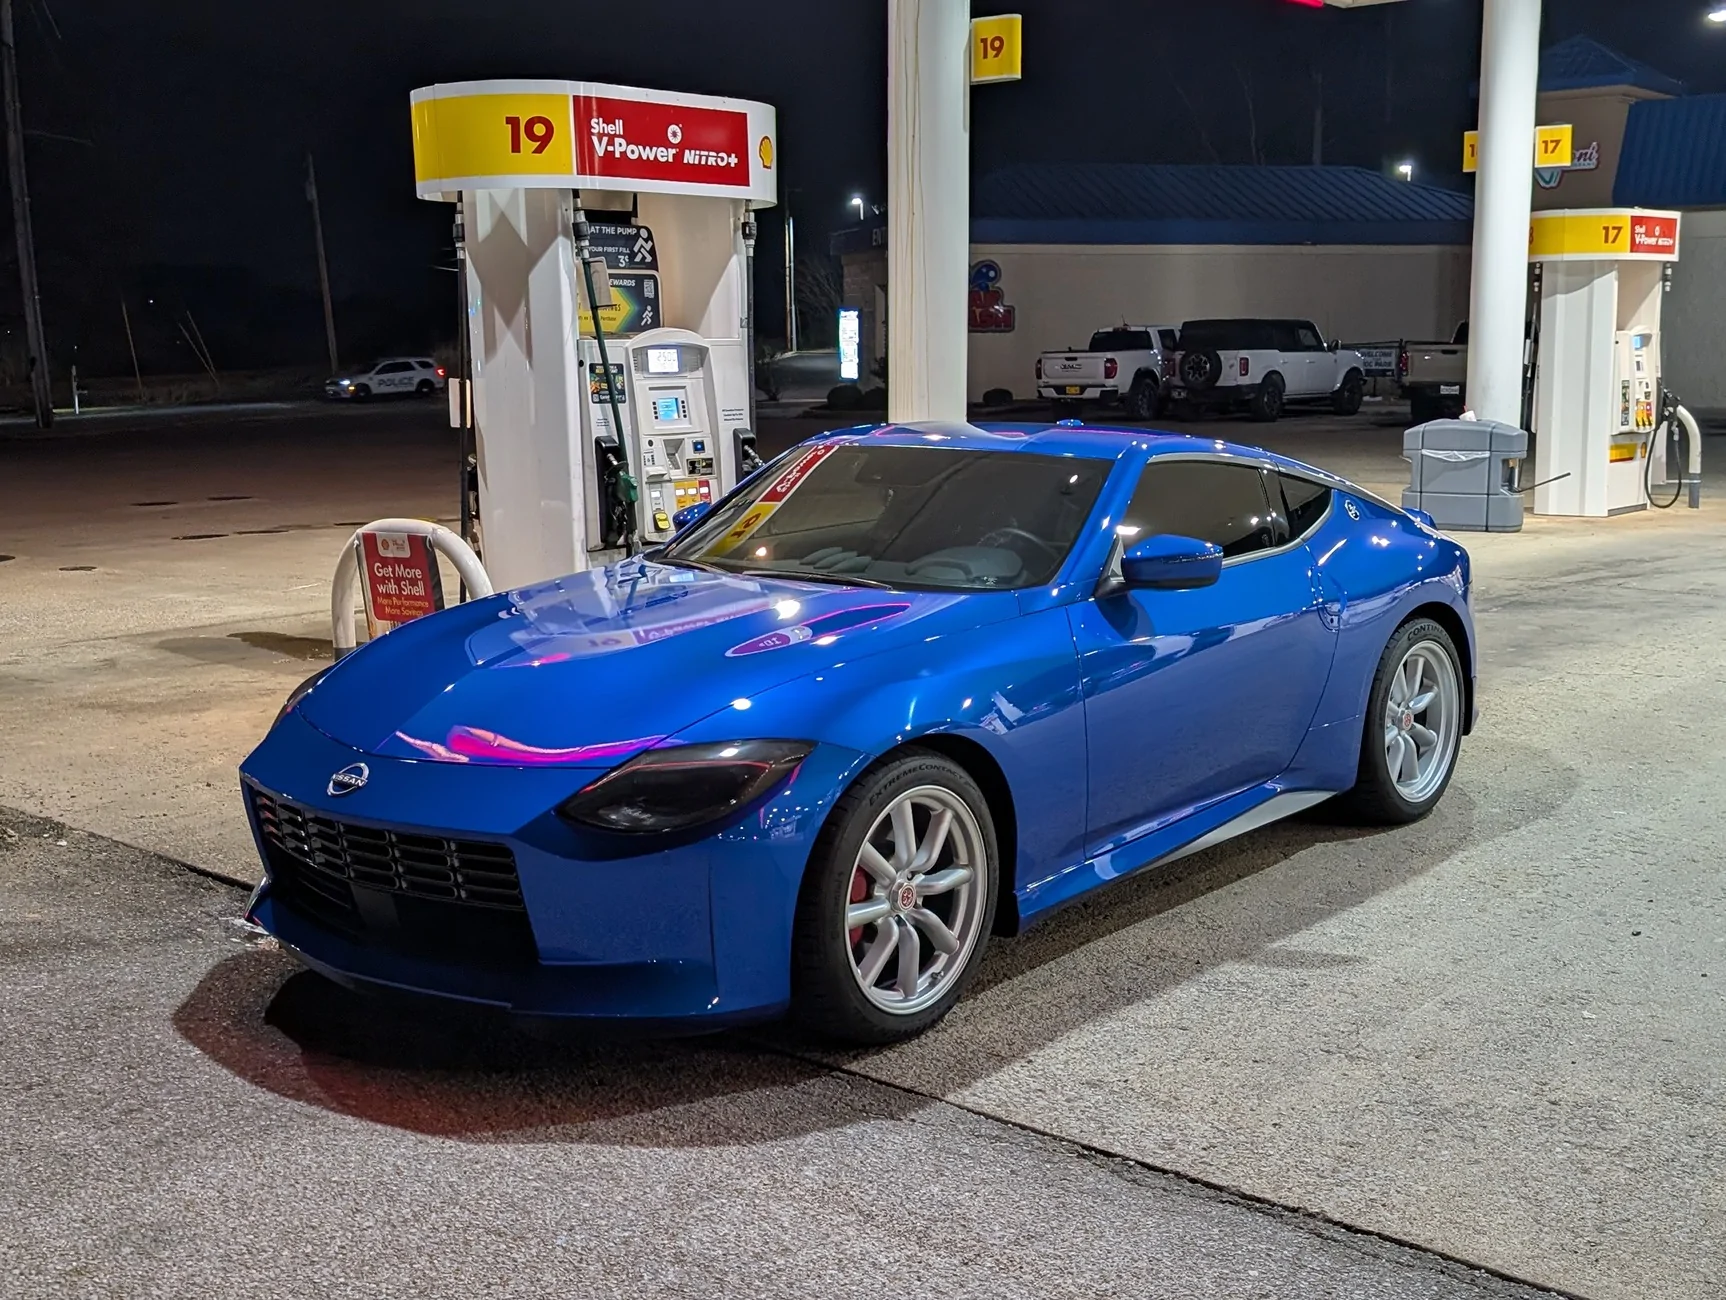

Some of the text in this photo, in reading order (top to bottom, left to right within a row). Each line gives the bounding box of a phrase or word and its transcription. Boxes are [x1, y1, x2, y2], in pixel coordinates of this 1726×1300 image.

[980, 35, 1005, 60] 19
[505, 115, 555, 154] 19
[590, 117, 624, 136] Shell
[591, 135, 677, 162] V-Power
[1469, 143, 1478, 158] 1
[1541, 138, 1563, 155] 17
[590, 225, 637, 236] AT THE PUMP
[1602, 225, 1624, 244] 17
[609, 278, 636, 287] EWARDS
[374, 562, 422, 579] Get More
[376, 578, 425, 596] with Shell
[377, 596, 429, 608] More Performance
[385, 605, 401, 615] More
